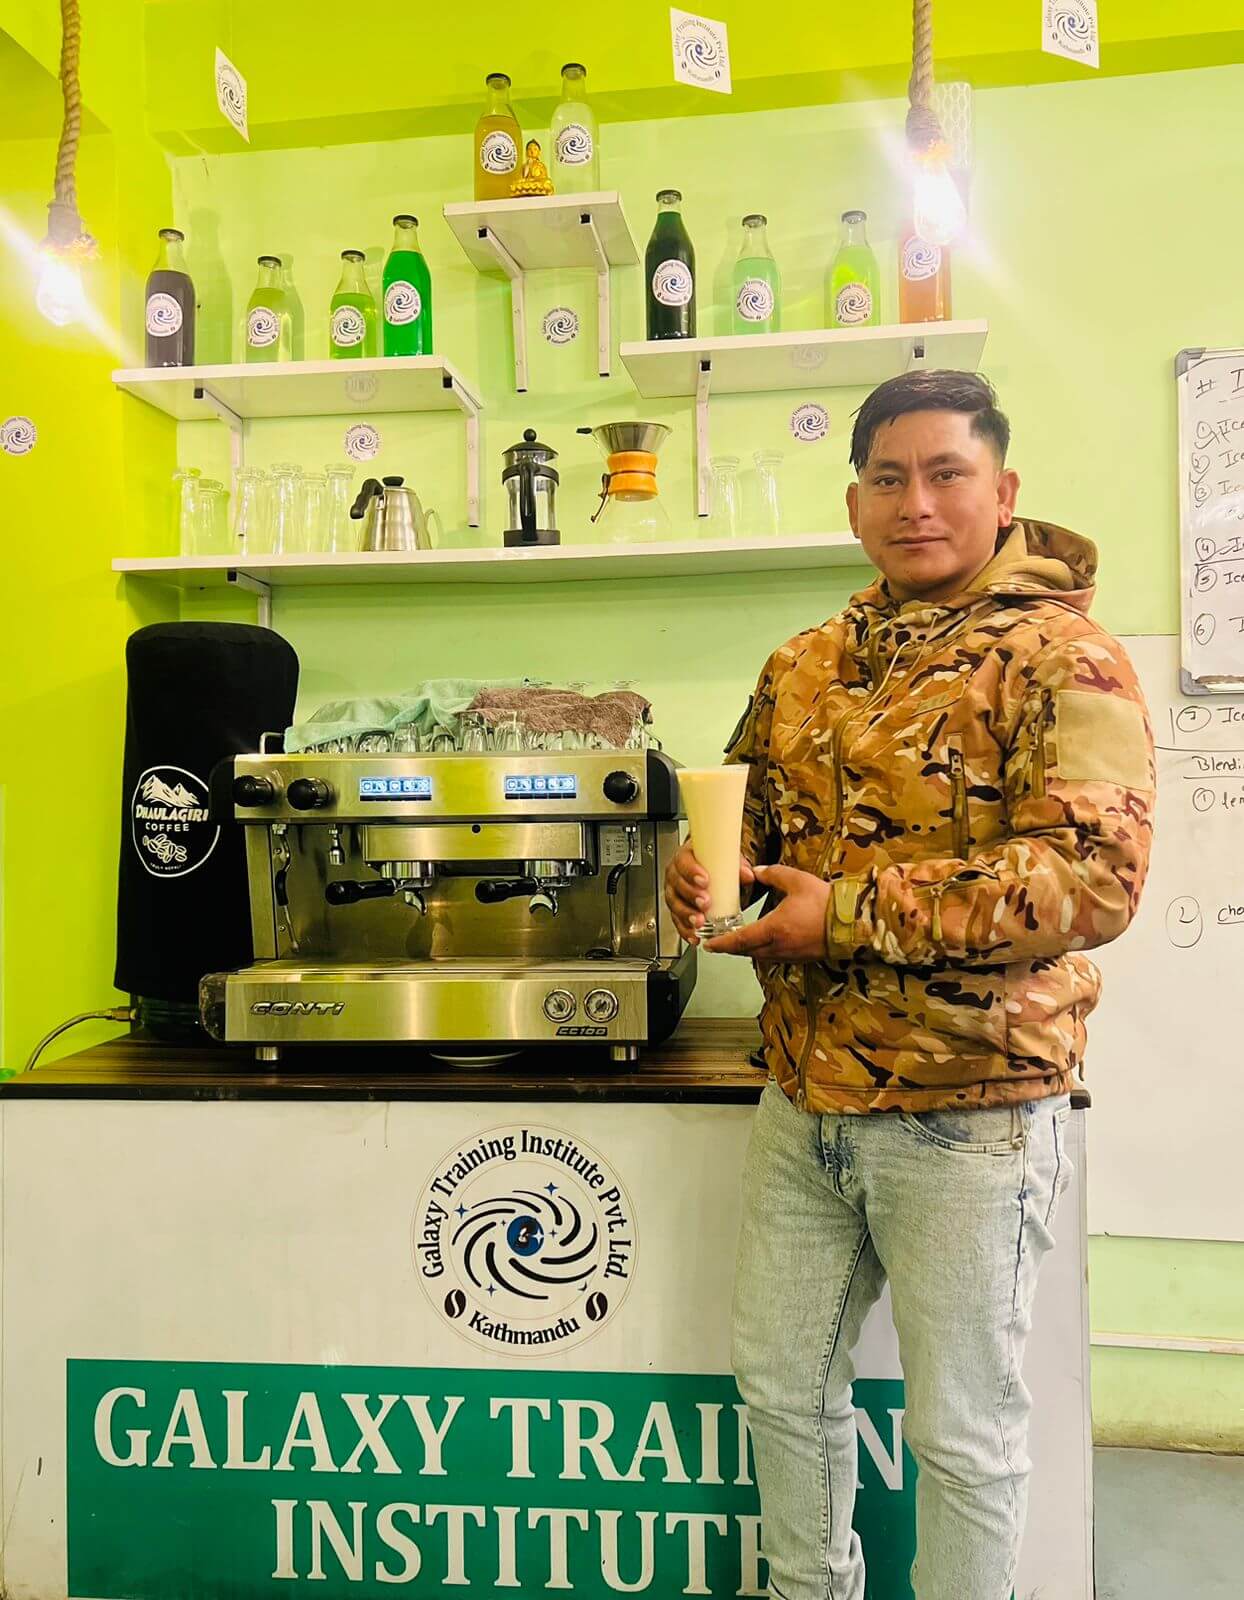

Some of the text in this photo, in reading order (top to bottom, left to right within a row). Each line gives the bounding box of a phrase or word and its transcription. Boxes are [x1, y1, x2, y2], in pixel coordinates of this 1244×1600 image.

[145, 822, 190, 832] COFFEE
[418, 1130, 632, 1279] Galaxy Training Institute Pvt. Ltd.
[467, 1311, 581, 1345] Kathmandu
[94, 1386, 465, 1476] GALAXY
